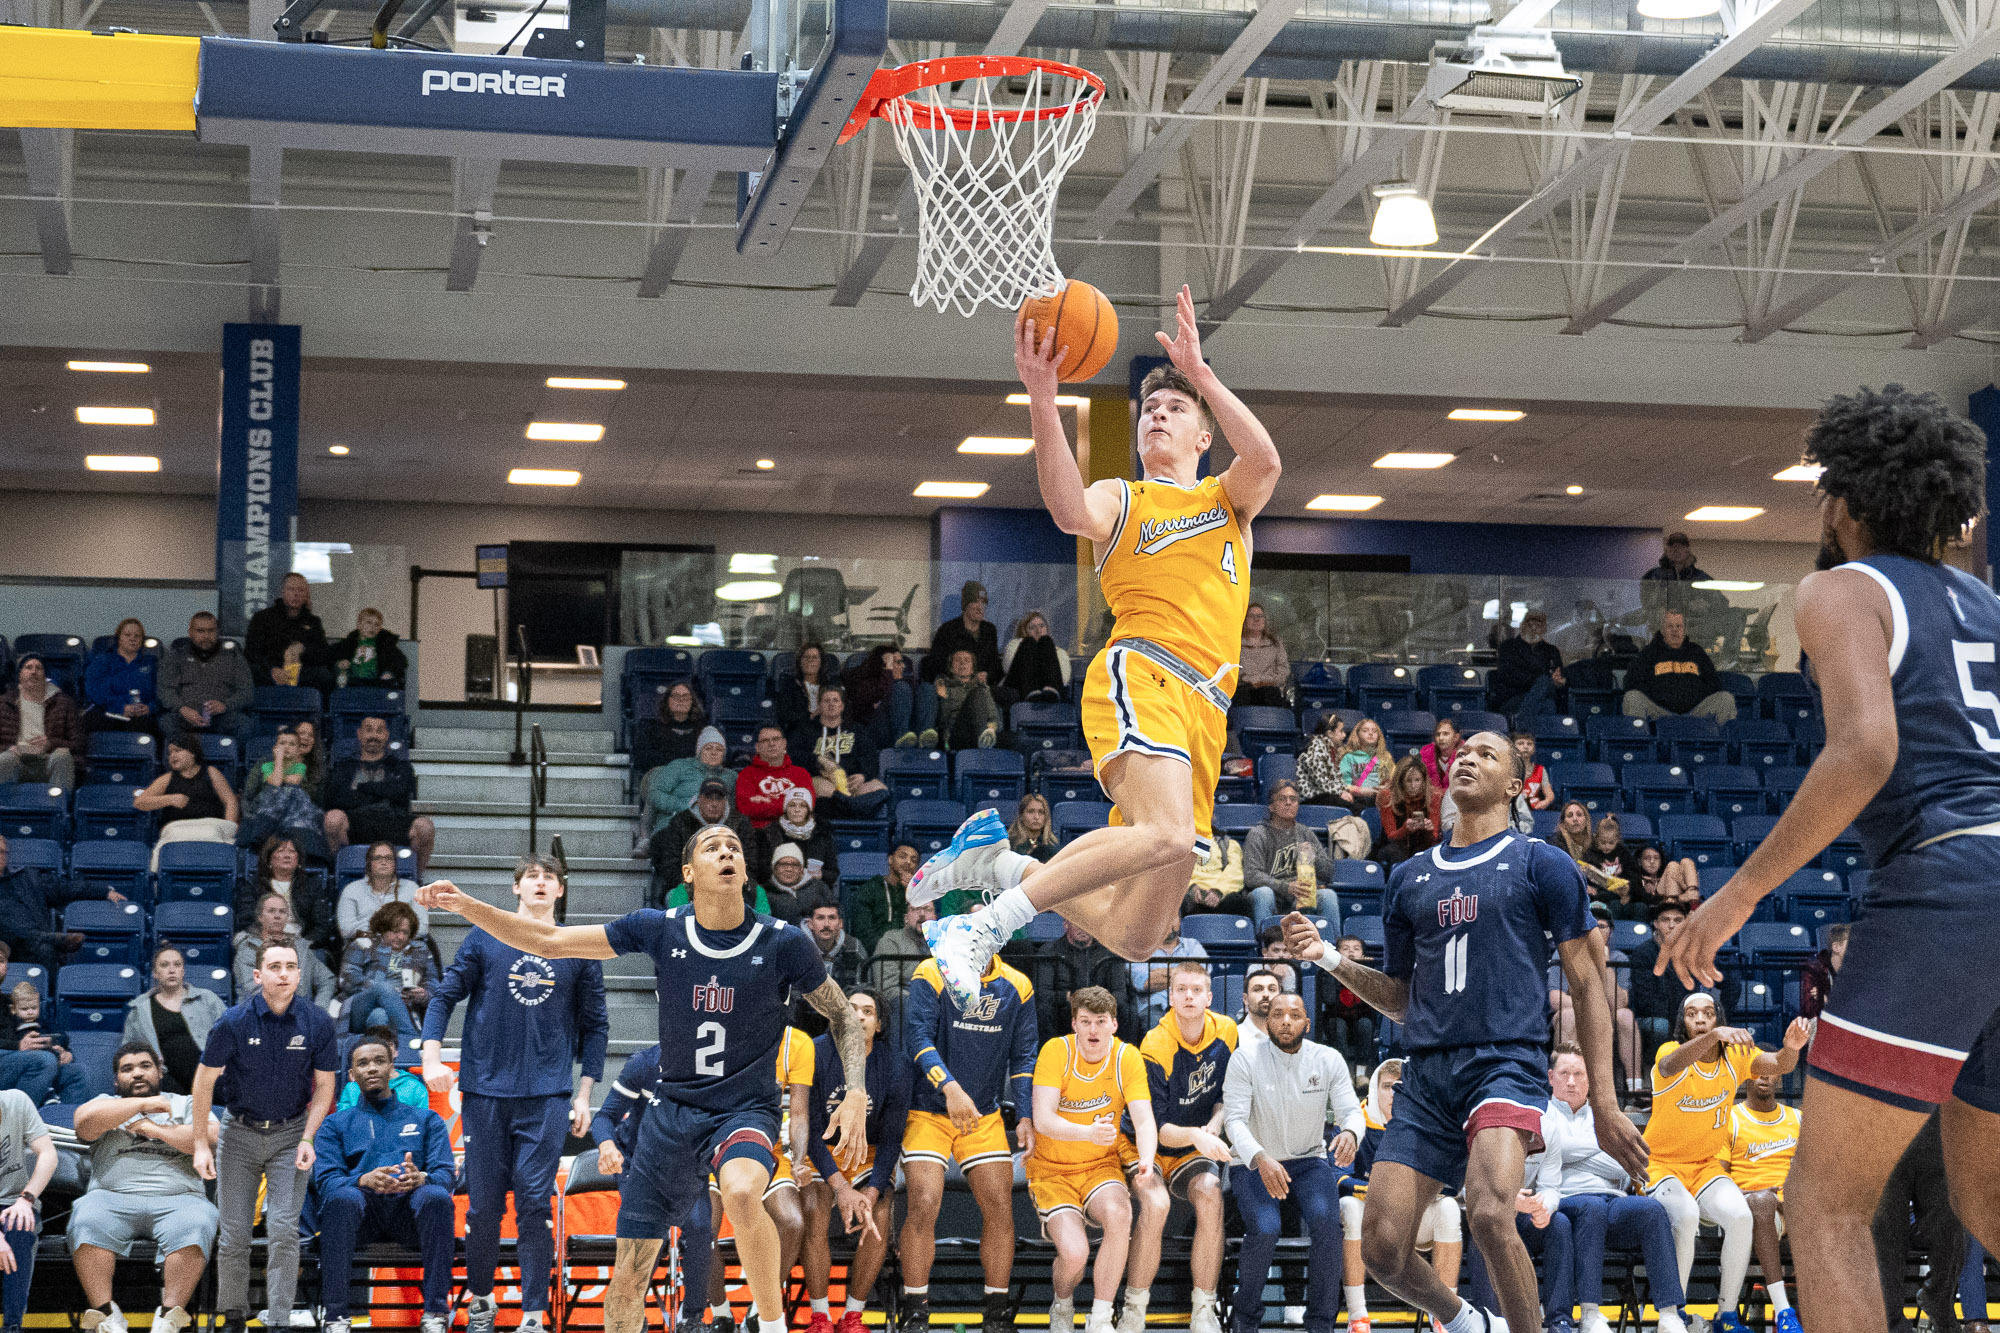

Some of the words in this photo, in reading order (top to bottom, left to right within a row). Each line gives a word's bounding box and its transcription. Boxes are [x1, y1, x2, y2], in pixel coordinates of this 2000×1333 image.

[248, 339, 274, 421] CLUB
[244, 428, 272, 621] CHAMPIONS
[1133, 500, 1229, 556] Merrimack
[1220, 540, 1239, 586] 4
[1951, 638, 2000, 753] 5
[1437, 893, 1479, 929] FDU
[1443, 932, 1469, 995] 11
[508, 980, 554, 1006] BASKETBALL
[691, 981, 735, 1014] FDU
[695, 1020, 727, 1077] 2
[952, 1020, 1003, 1033] BASKETBALL
[1744, 1134, 1798, 1160] Merrimack
